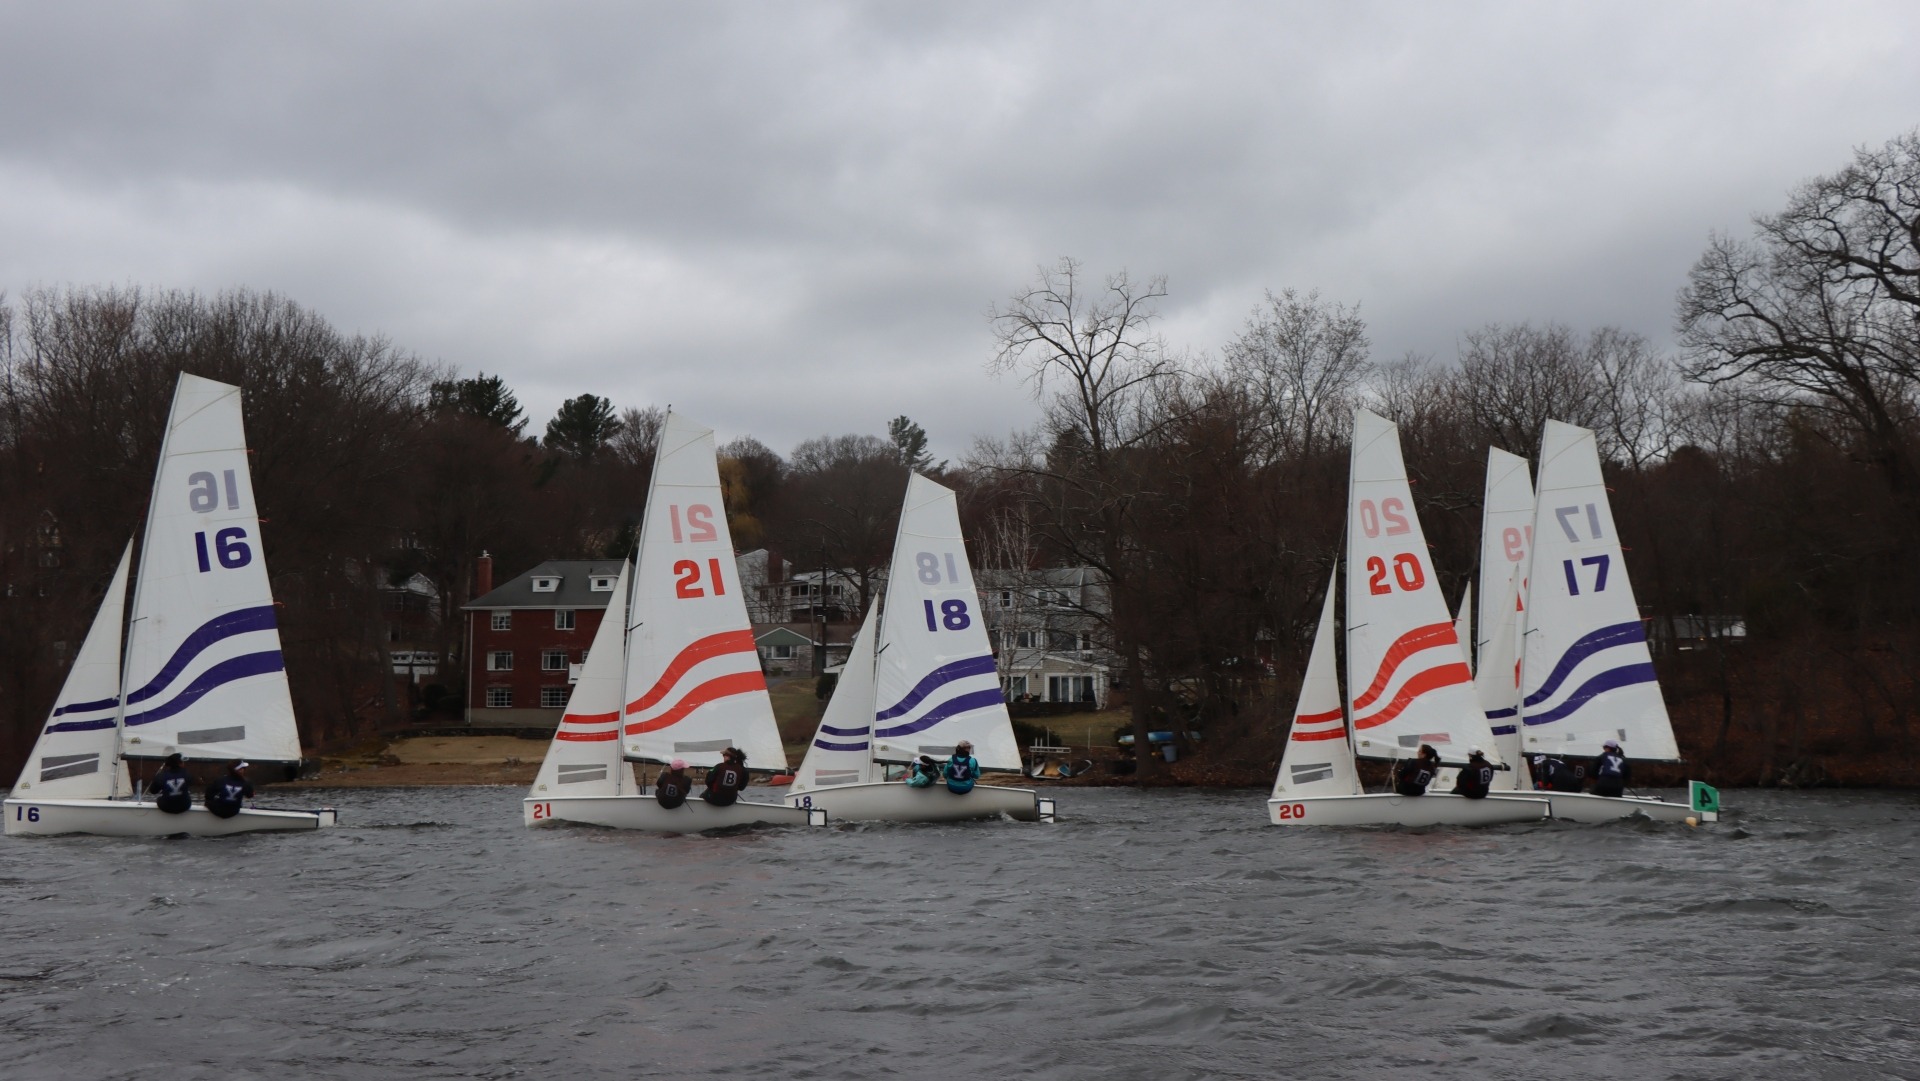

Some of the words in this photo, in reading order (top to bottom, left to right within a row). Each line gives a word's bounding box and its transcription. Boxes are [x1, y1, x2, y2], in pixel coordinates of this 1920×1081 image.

[194, 526, 252, 573] 16
[673, 558, 726, 599] 21
[1366, 552, 1425, 596] 20
[1563, 554, 1610, 596] 17
[923, 599, 971, 632] 18
[952, 763, 969, 780] Y
[1606, 755, 1625, 774] Y
[722, 769, 738, 787] B
[1415, 769, 1432, 787] B
[1480, 767, 1493, 785] B
[166, 778, 186, 797] Y
[225, 783, 243, 802] Y
[665, 783, 679, 798] B
[533, 802, 552, 819] 21
[795, 796, 812, 809] 18
[1279, 803, 1306, 820] 20
[17, 806, 40, 823] 16
